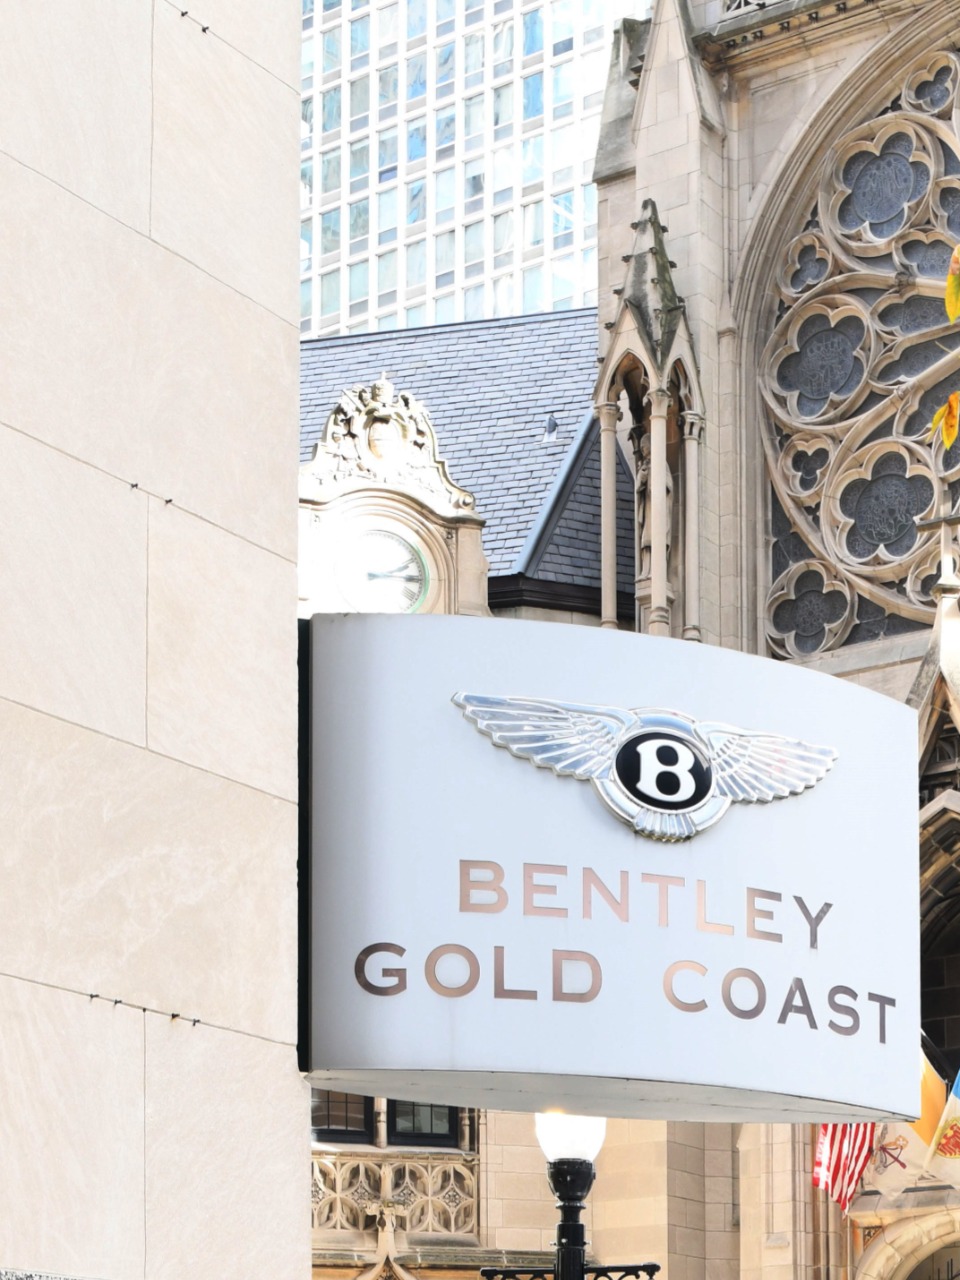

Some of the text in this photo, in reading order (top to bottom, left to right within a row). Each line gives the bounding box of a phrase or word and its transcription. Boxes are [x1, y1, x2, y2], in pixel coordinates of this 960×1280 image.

[635, 738, 696, 802] B
[459, 859, 834, 949] BENTLEY
[354, 942, 896, 1044] GOLD COAST
